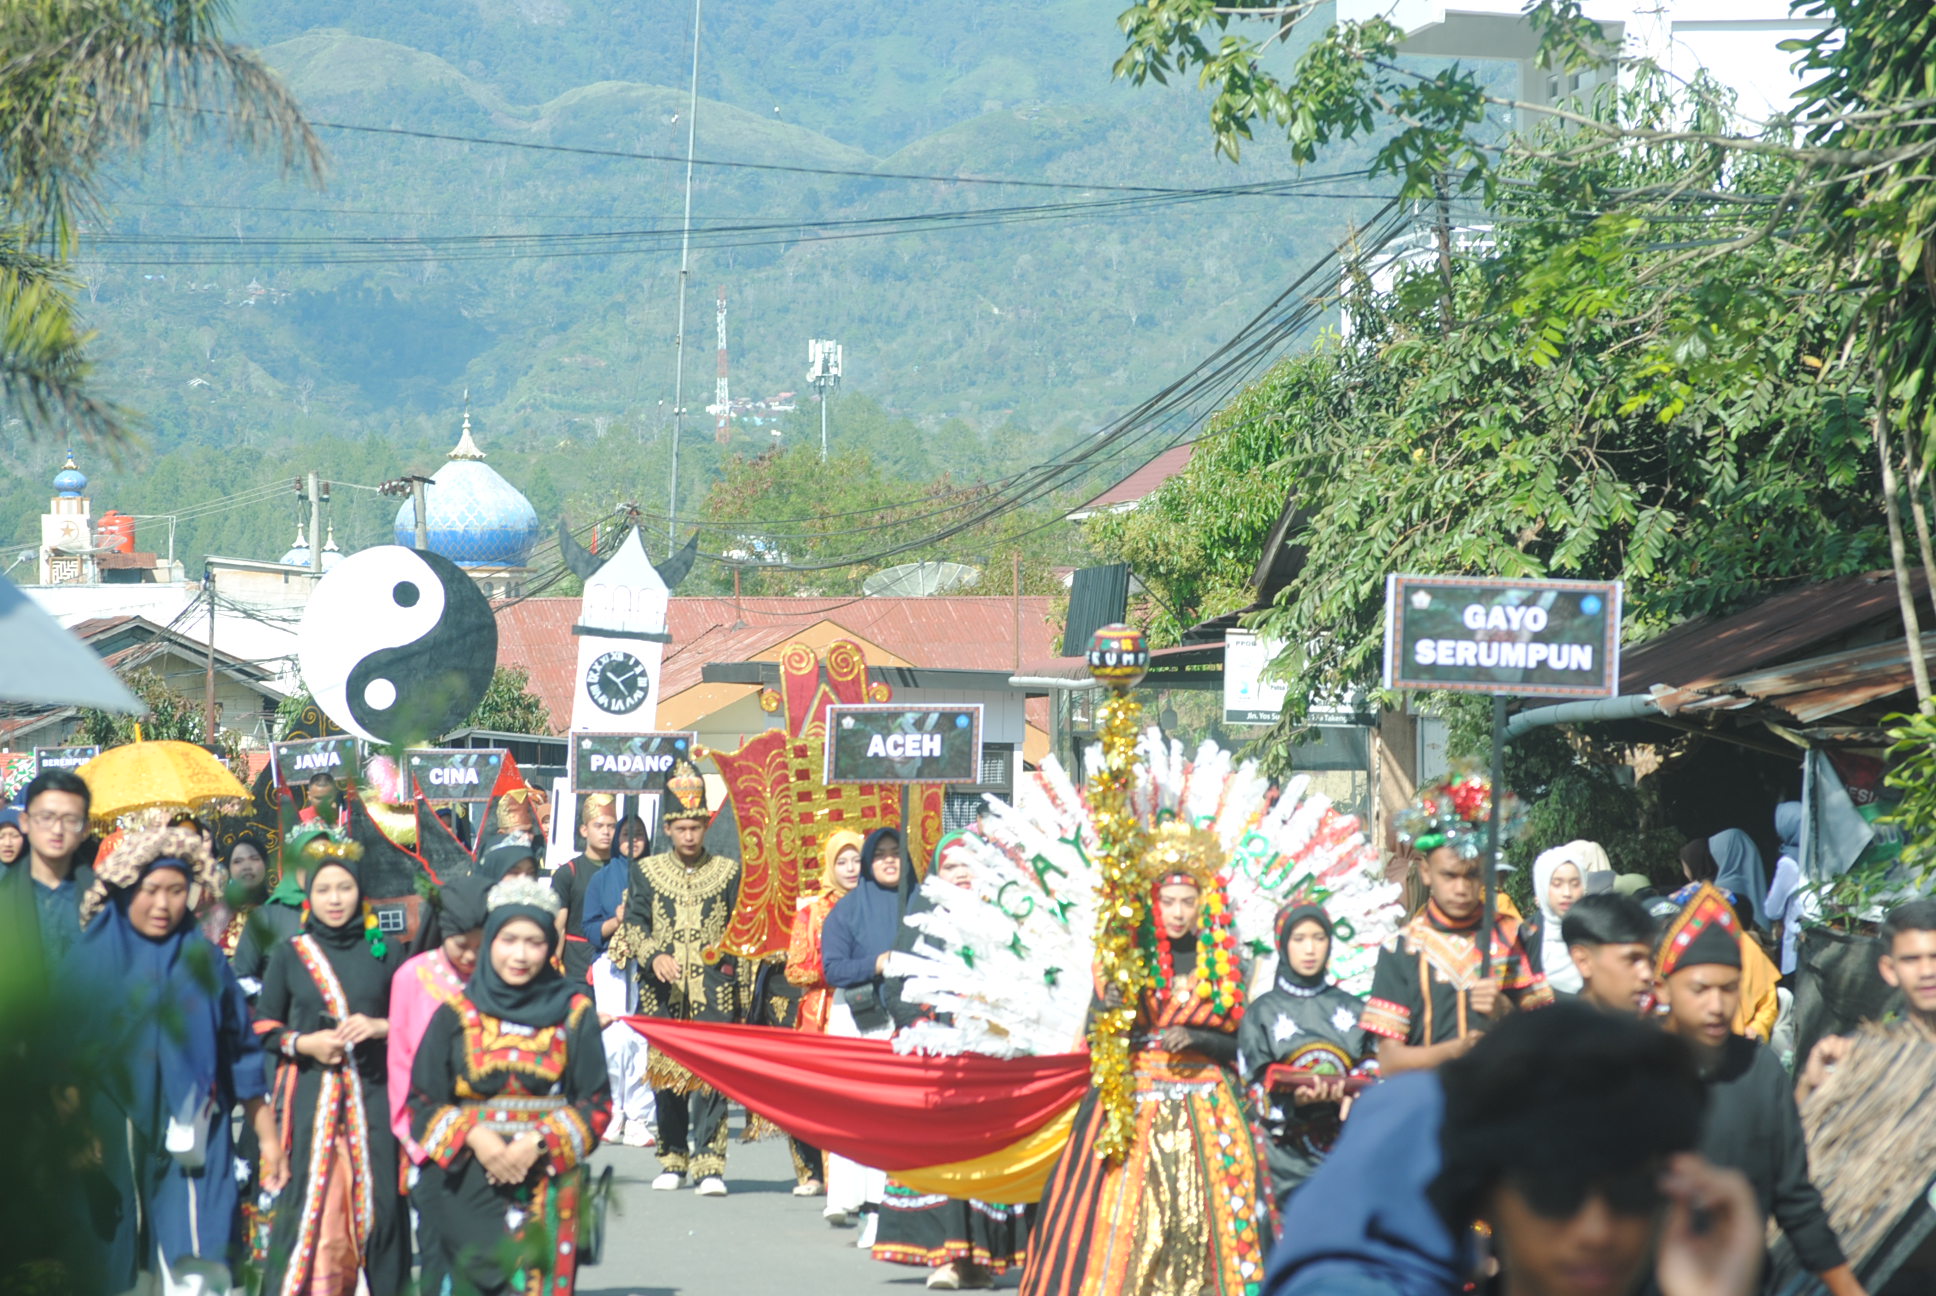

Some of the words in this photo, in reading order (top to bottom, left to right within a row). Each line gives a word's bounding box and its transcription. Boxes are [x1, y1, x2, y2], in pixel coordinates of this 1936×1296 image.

[1463, 604, 1548, 632] GAYO
[1414, 638, 1593, 671] SERUMPUN
[1259, 711, 1270, 720] Yos
[867, 734, 942, 757] ACEH
[293, 752, 341, 770] JAWA
[590, 754, 674, 772] PADANG
[429, 767, 479, 785] CINA
[998, 823, 1091, 919] GAY
